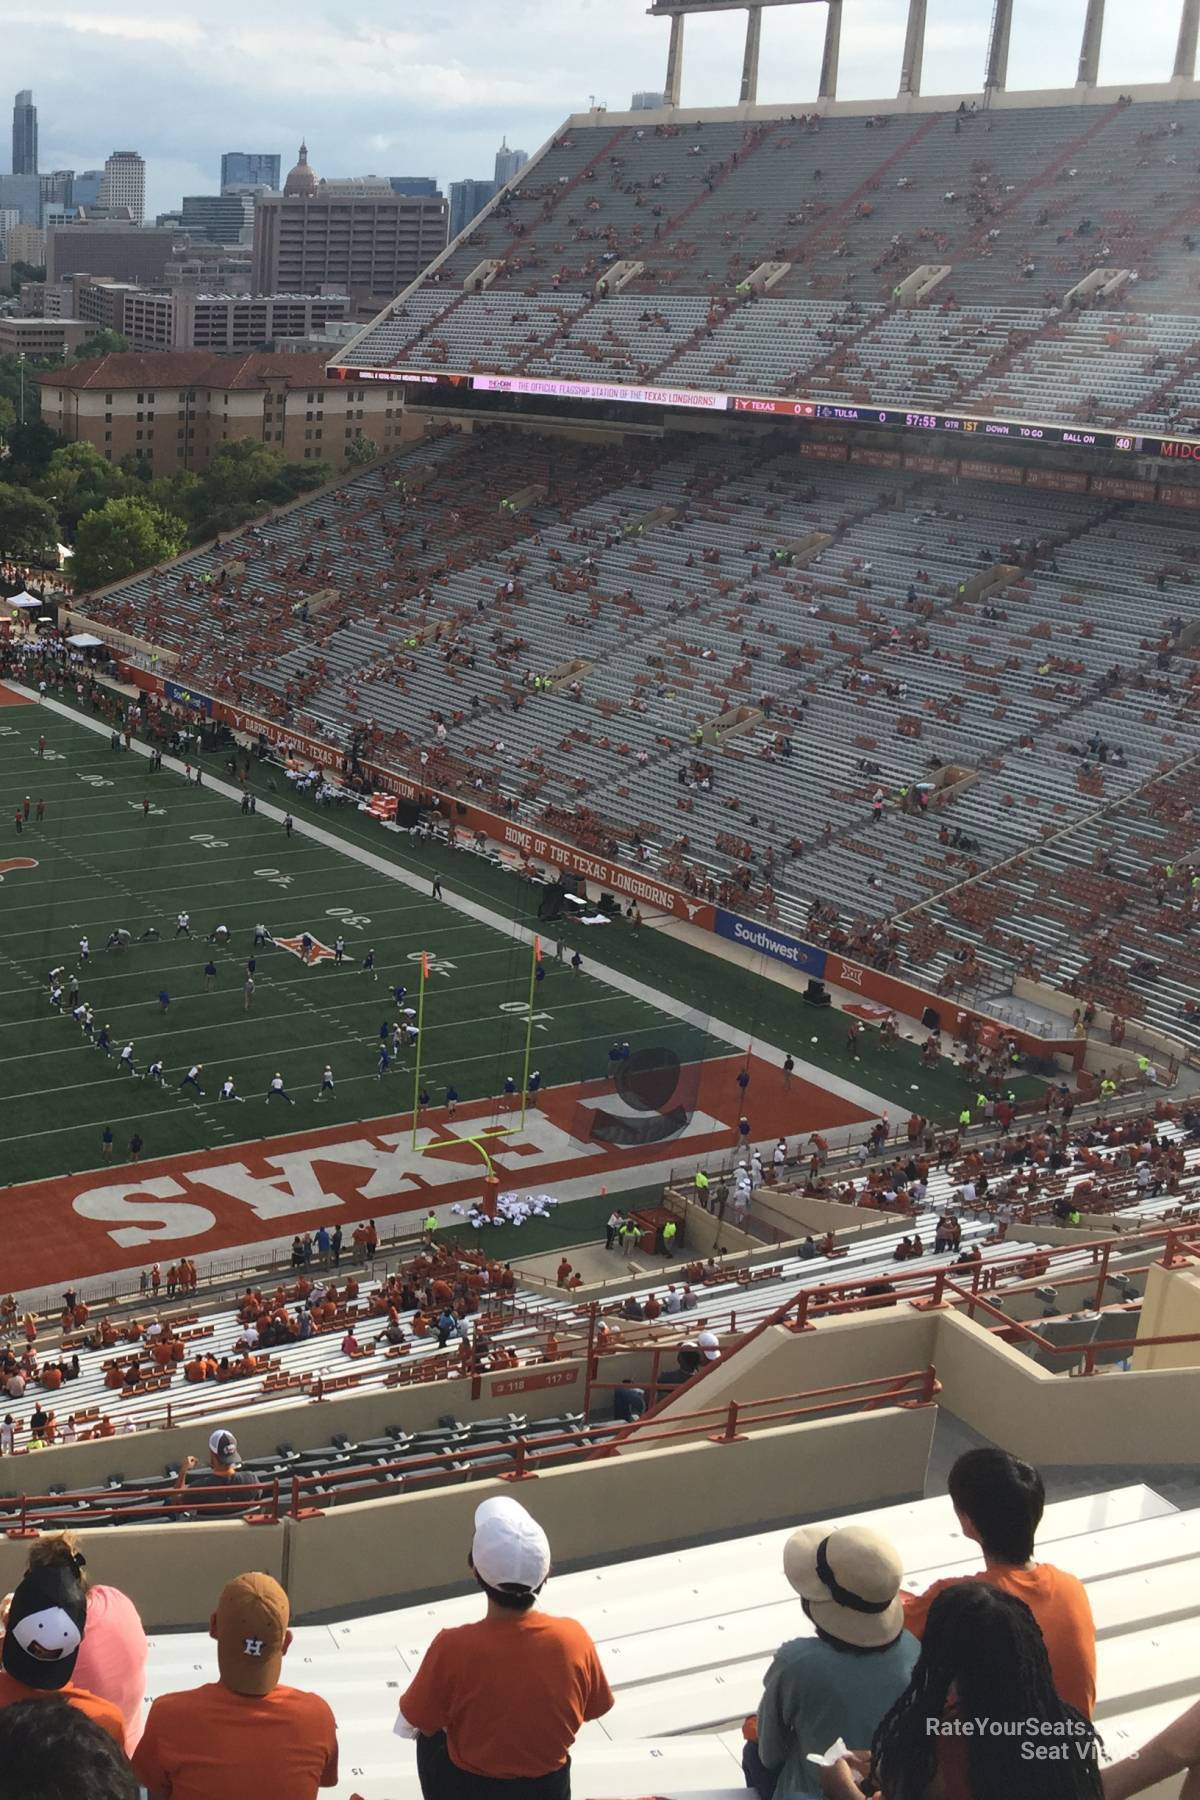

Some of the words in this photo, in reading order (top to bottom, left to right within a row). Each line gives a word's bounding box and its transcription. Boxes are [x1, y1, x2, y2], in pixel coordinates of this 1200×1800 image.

[518, 382, 529, 391] THE
[530, 383, 557, 393] OFFICIAL
[559, 384, 590, 395] FLAGSHIP
[592, 387, 618, 397] STATION
[620, 389, 629, 398] OF
[630, 390, 643, 399] THE
[644, 391, 667, 402] TEXAS
[751, 402, 776, 412] TEXAS
[794, 405, 801, 414] 0
[834, 409, 858, 419] TULSA
[879, 412, 886, 422] 0
[906, 414, 937, 428] 57:55
[944, 419, 959, 429] QTR
[963, 421, 978, 432] 1ST
[985, 424, 1009, 435] DOWN
[1020, 427, 1030, 437] TO
[1031, 429, 1044, 438] GO
[1063, 432, 1082, 443] BALL
[1083, 434, 1095, 444] ON
[1116, 438, 1130, 449] 40
[245, 720, 274, 741] DARRELL
[377, 774, 415, 797] STADIUM
[505, 826, 531, 850] HOME
[534, 839, 547, 856] OF
[550, 846, 570, 867] THE
[573, 855, 607, 881] TEXAS
[610, 869, 675, 910] LONGHORNS
[734, 922, 799, 963] Southwest
[71, 1092, 731, 1249] TEXAS
[244, 1638, 263, 1656] H
